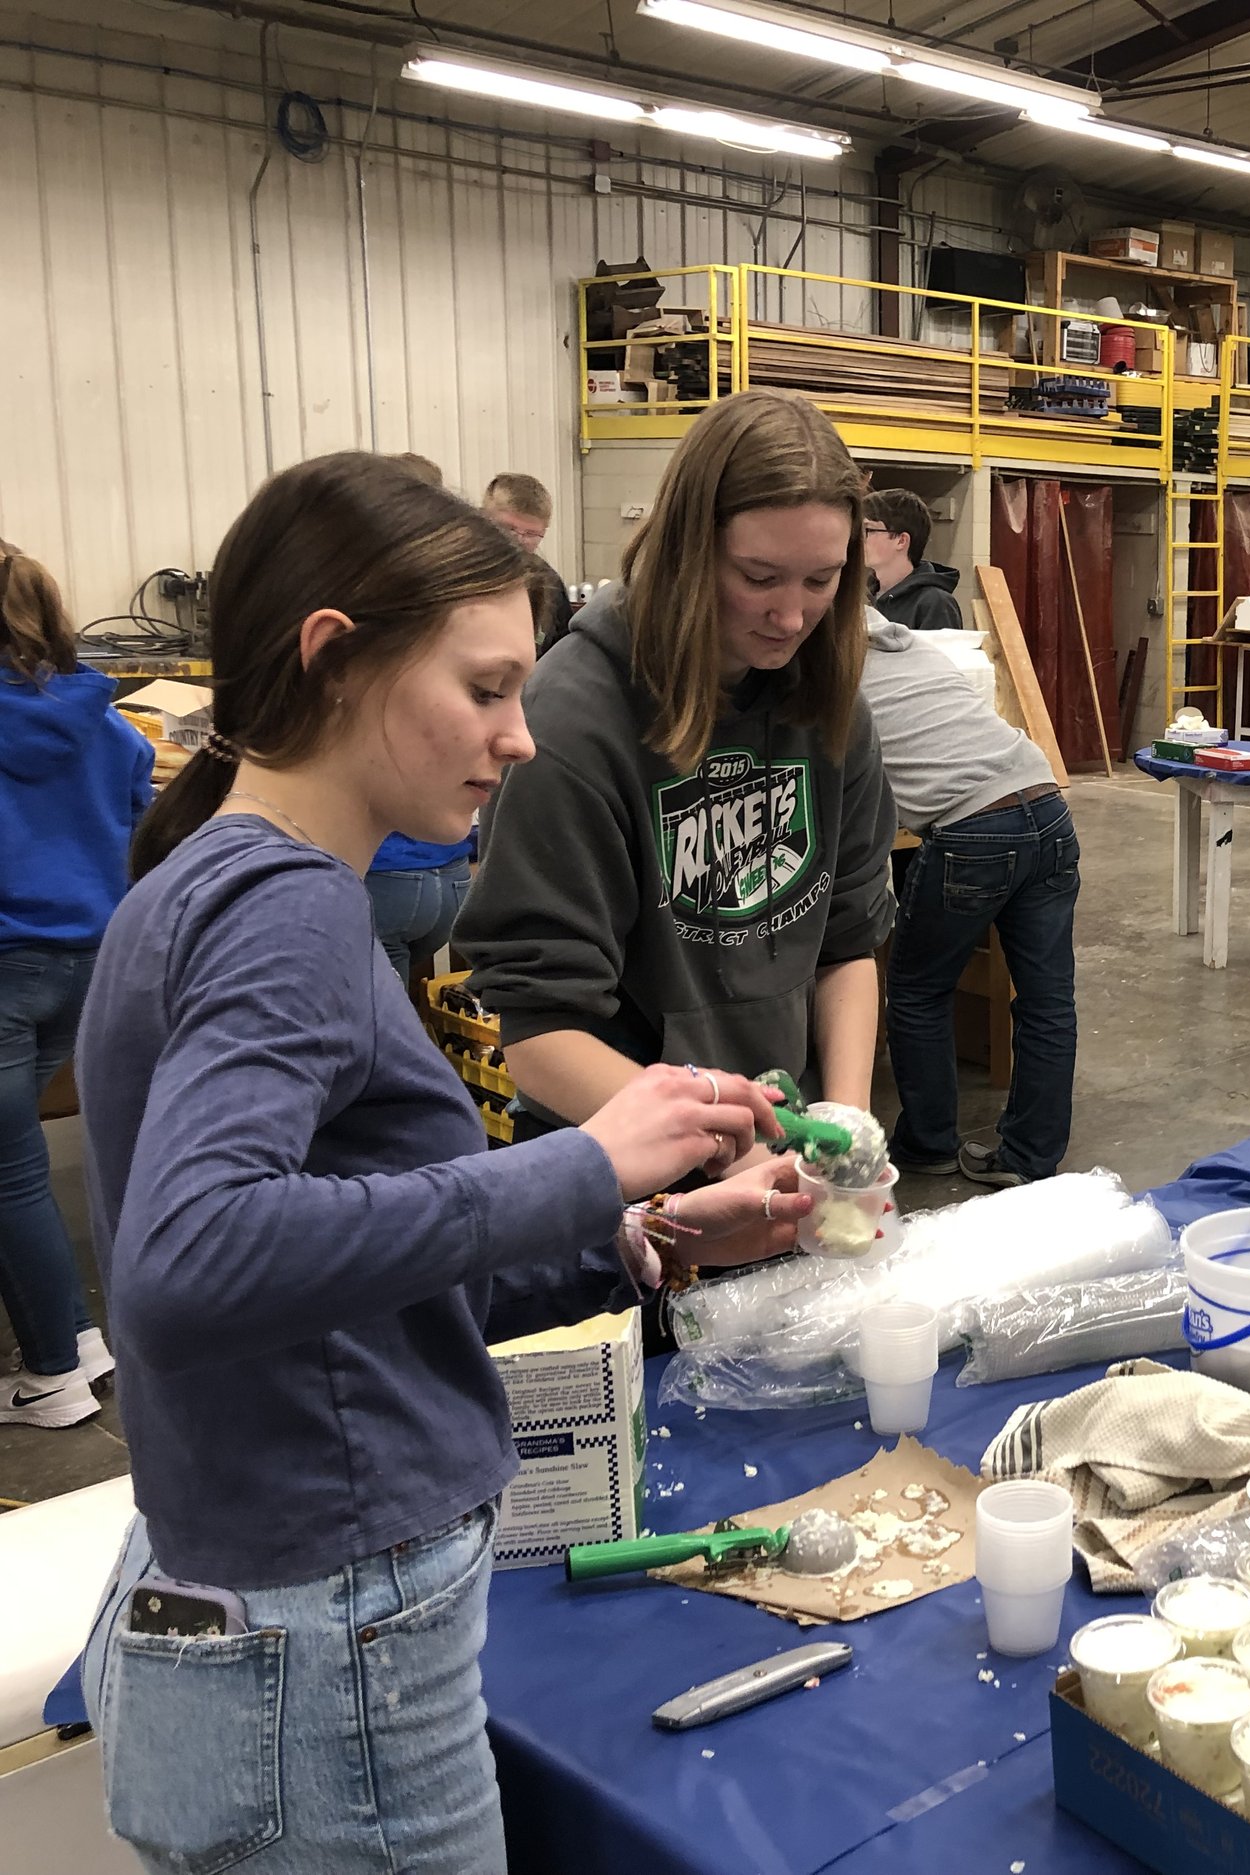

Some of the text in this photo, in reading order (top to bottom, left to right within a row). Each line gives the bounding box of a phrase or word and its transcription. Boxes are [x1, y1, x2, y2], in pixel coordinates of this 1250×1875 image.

[708, 758, 746, 778] 2015
[739, 864, 767, 902] SWEE
[756, 872, 830, 938] CHAMPS
[520, 1447, 559, 1455] RECIPES
[535, 1464, 568, 1474] Sunshine
[571, 1462, 589, 1470] Slaw
